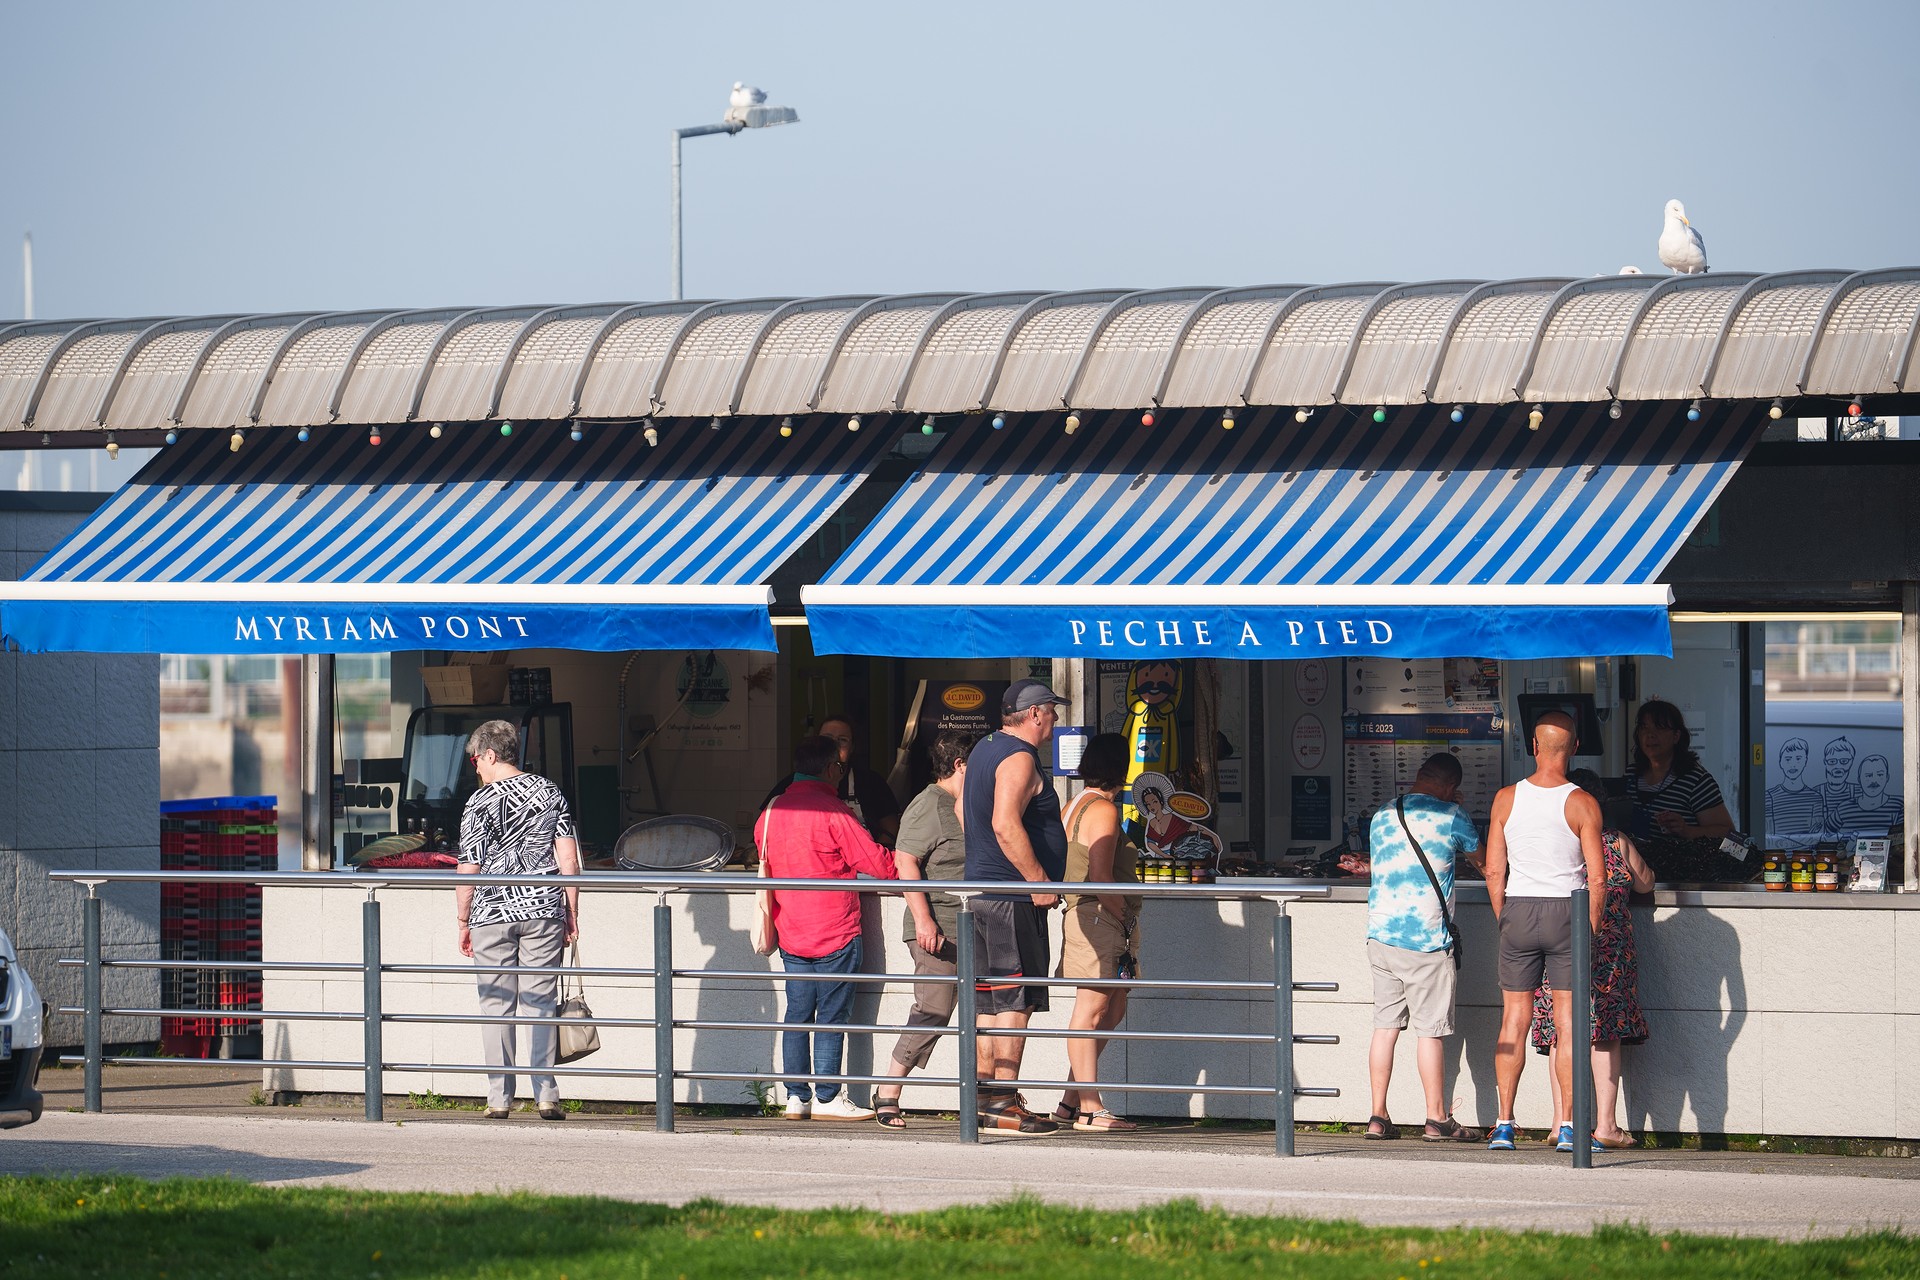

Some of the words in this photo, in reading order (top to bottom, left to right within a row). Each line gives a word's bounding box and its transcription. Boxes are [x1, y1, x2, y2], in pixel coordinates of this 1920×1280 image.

[234, 615, 399, 641] MYRIAM
[418, 616, 530, 639] PONT
[1068, 619, 1212, 646] PECHE
[1237, 620, 1263, 646] A
[1285, 619, 1394, 646] PIED
[1100, 662, 1126, 671] VENTE
[1360, 721, 1374, 733] ÉTÉ
[1375, 724, 1394, 733] 2023
[1755, 749, 1761, 761] 6
